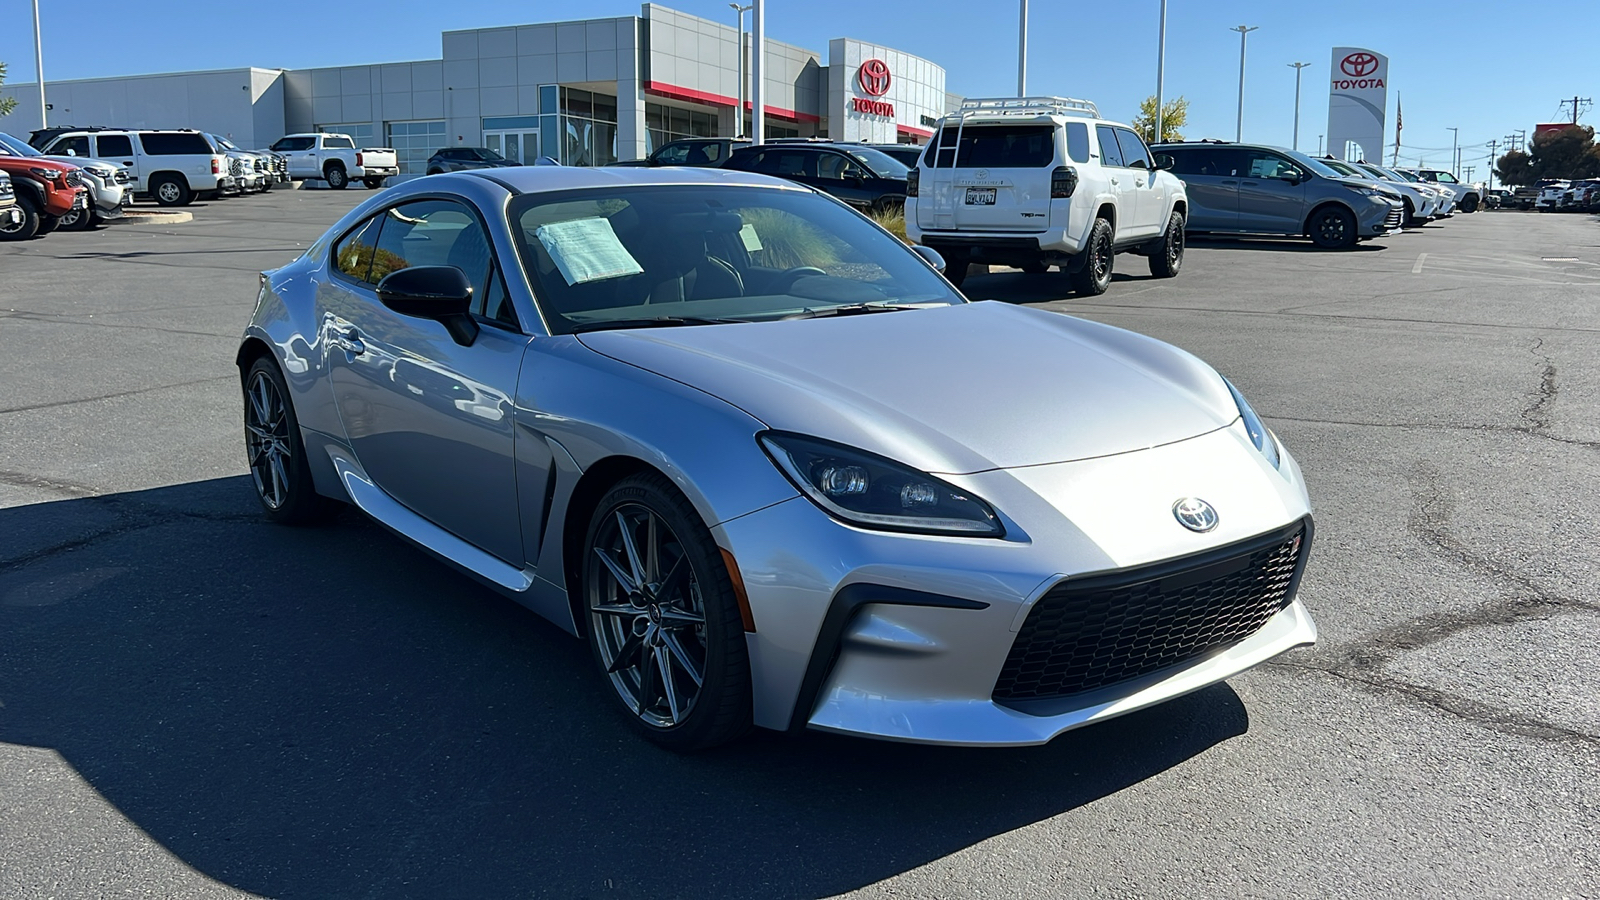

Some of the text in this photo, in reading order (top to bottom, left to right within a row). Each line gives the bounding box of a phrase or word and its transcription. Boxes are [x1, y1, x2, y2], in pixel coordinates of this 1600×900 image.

[1333, 78, 1384, 90] TOYOTA
[852, 98, 894, 117] TOYOTA
[613, 488, 645, 498] MICHELIN
